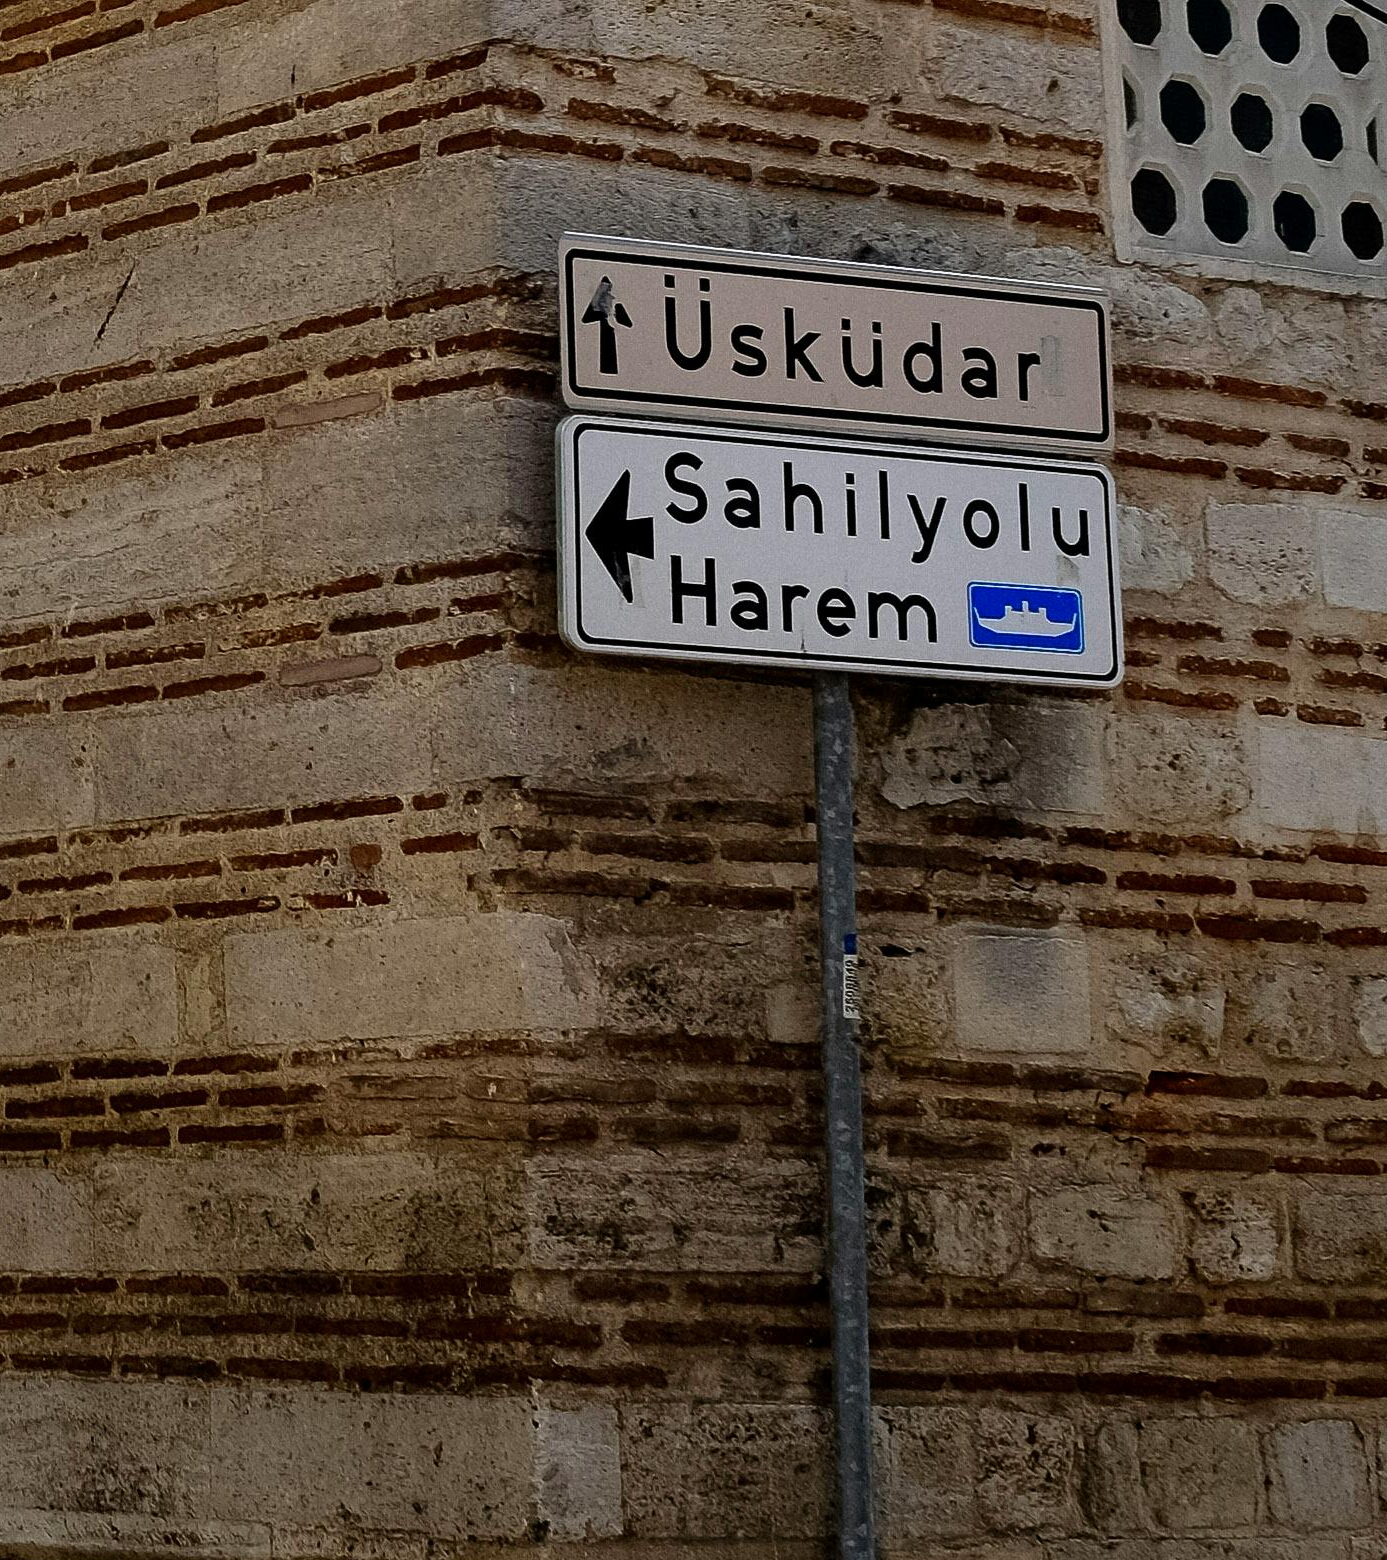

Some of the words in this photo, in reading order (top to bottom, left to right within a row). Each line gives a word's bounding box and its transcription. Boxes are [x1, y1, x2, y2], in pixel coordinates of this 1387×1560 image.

[663, 274, 1041, 402] Üsküdar
[663, 451, 1090, 565] Sahilyolu
[669, 555, 939, 644] Harem
